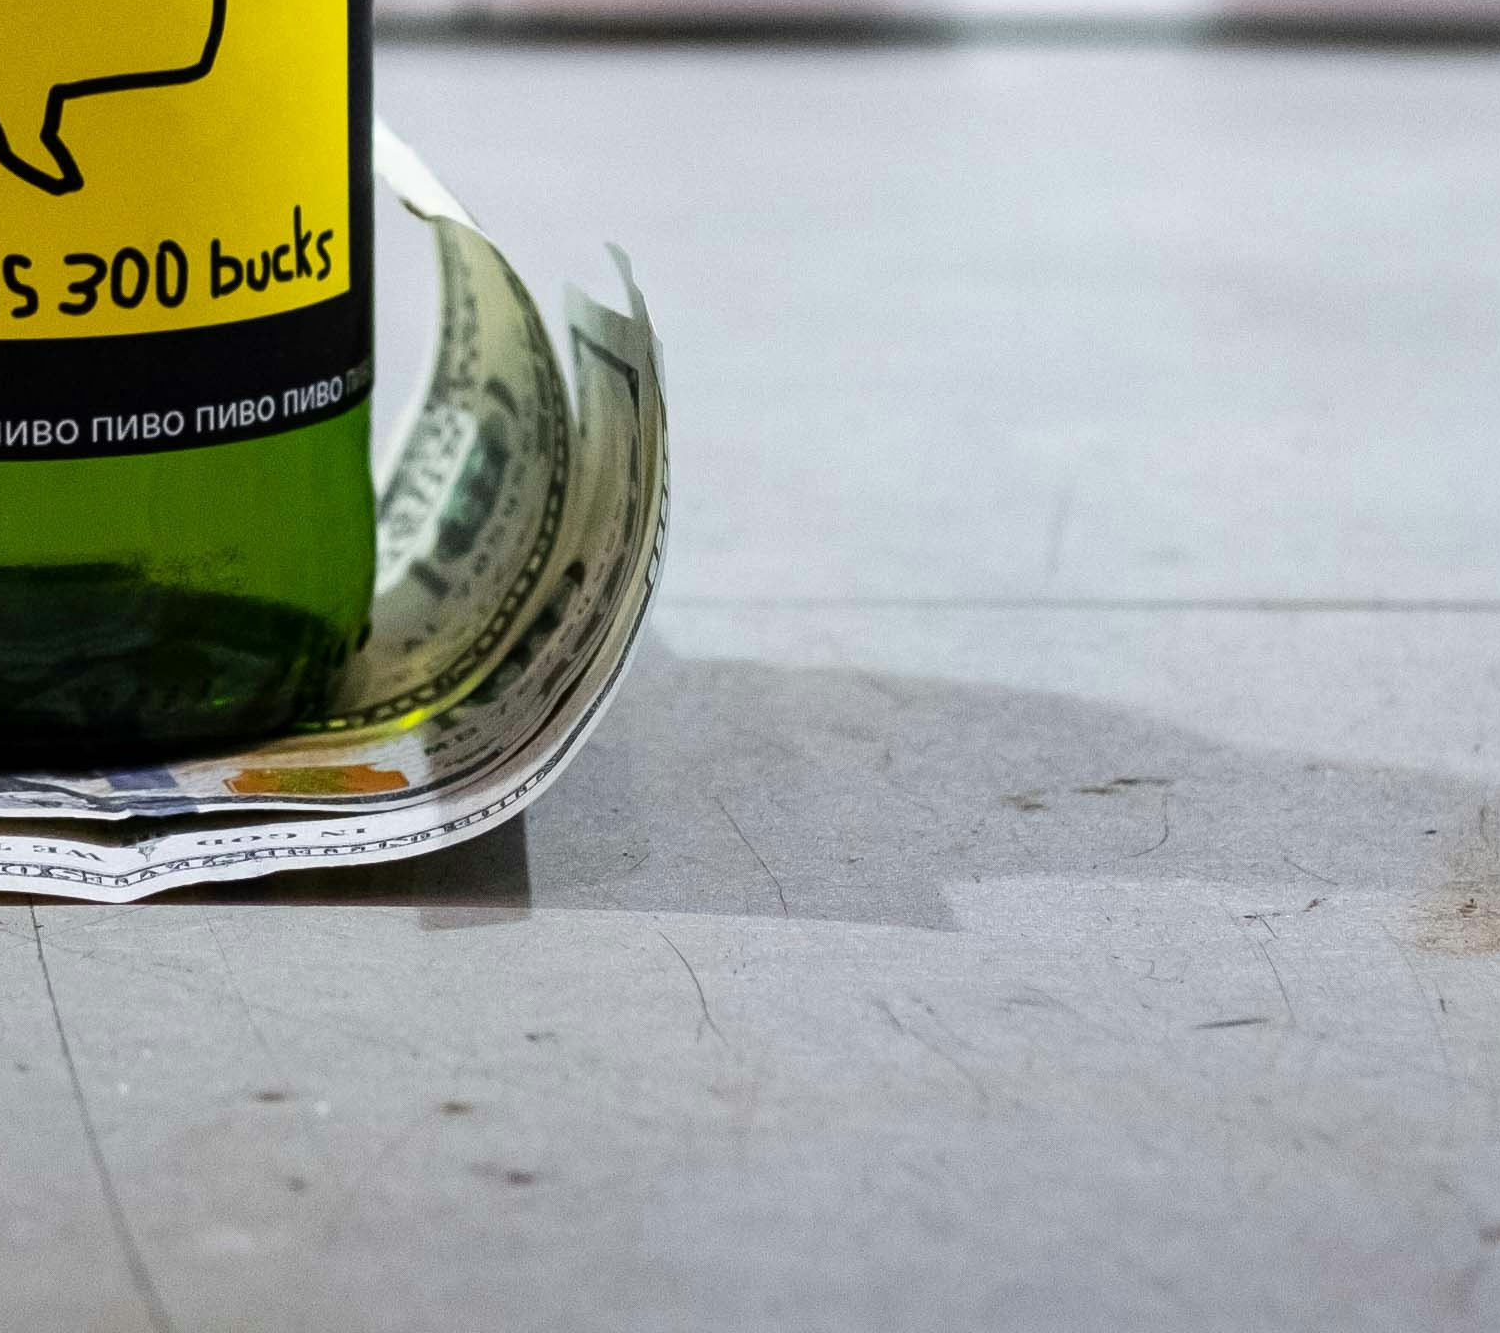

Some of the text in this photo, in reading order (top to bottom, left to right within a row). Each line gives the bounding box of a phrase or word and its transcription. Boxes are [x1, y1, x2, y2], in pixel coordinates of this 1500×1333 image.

[58, 238, 190, 317] 300
[209, 204, 334, 299] bucks
[91, 410, 186, 443] ПИВО
[195, 395, 277, 433] ПИВО
[283, 375, 344, 418] ПИВО
[32, 842, 106, 862] WE
